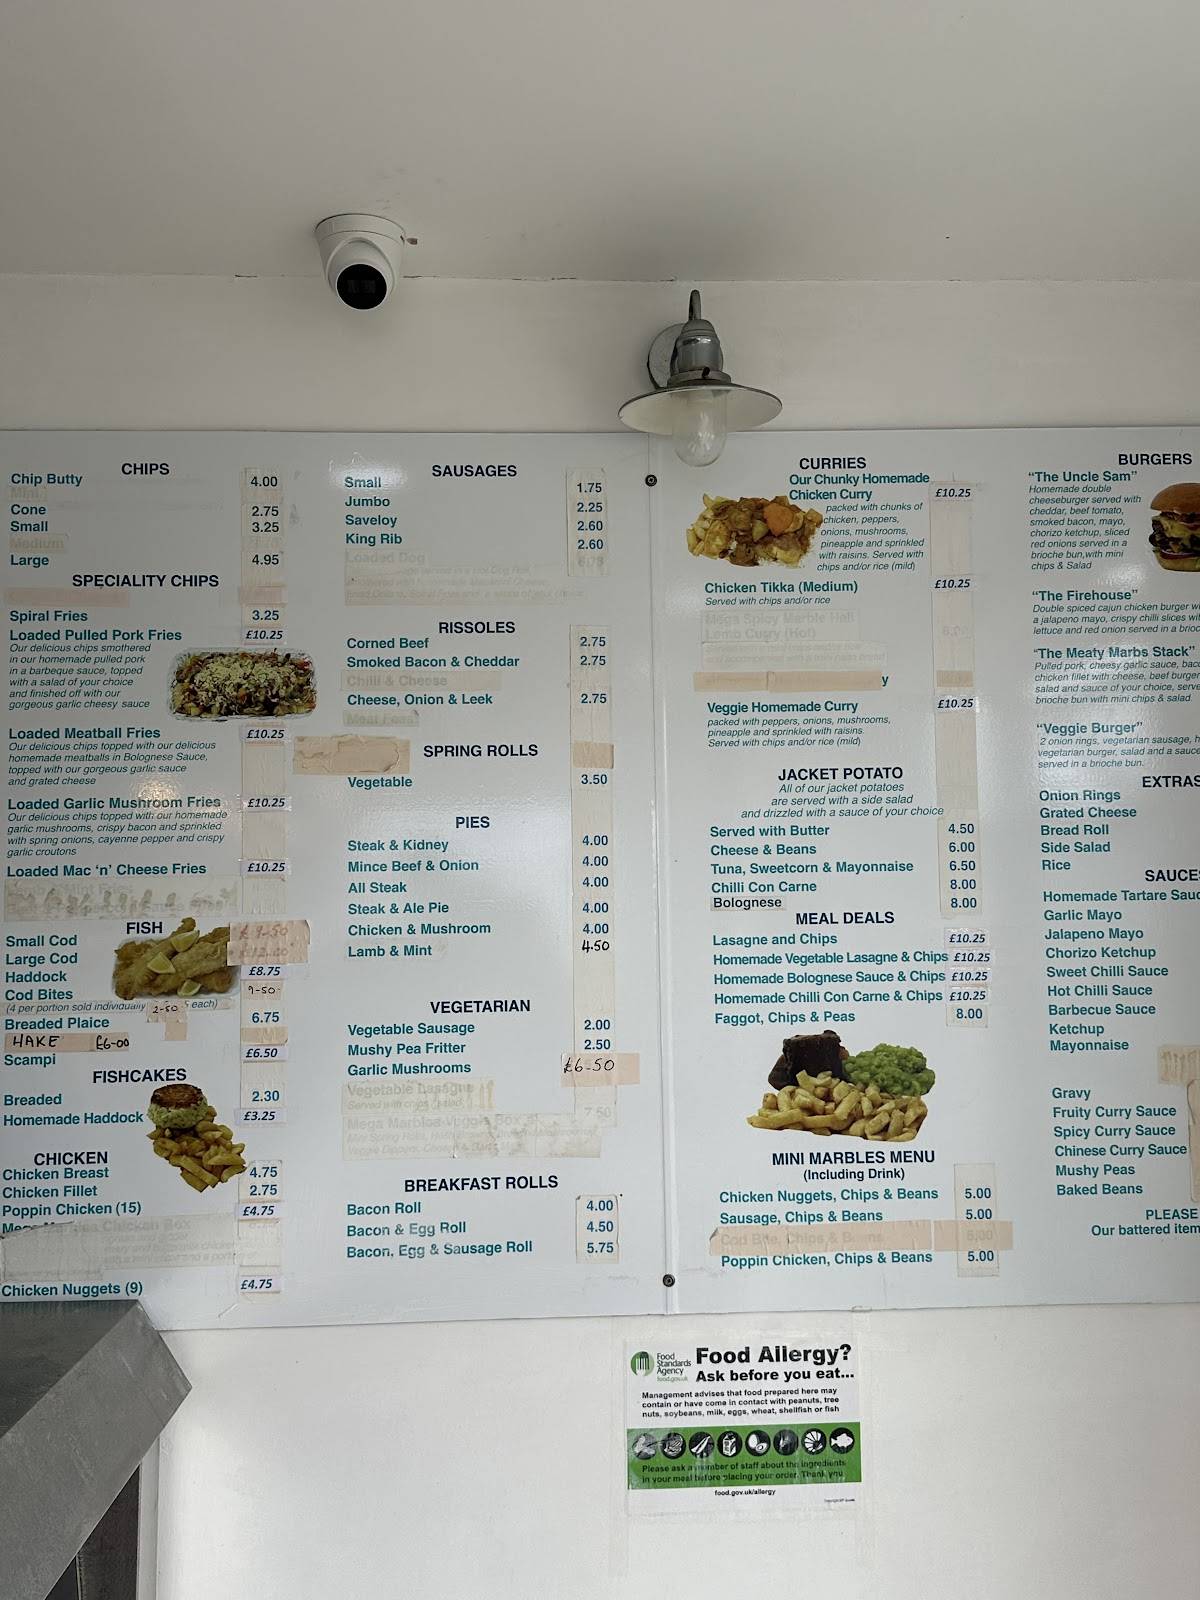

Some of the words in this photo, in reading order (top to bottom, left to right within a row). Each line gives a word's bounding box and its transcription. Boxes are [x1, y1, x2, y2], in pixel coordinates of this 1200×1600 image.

[799, 456, 866, 469] CURRIES
[1118, 452, 1192, 465] BURGERS
[121, 462, 169, 475] CHIPS
[431, 464, 517, 477] SAUSAGES
[11, 472, 42, 487] Chip
[46, 473, 83, 487] Butty
[250, 476, 277, 487] 4.00
[789, 473, 811, 485] Our
[813, 473, 859, 487] Chunky
[862, 472, 930, 484] Homemade
[1062, 471, 1099, 482] Uncle
[789, 489, 837, 500] Chicken
[839, 488, 872, 502] Curry
[935, 488, 971, 497] £10.25
[1028, 484, 1080, 494] Homemade
[1081, 483, 1111, 493] double
[10, 503, 46, 515] Cone
[251, 505, 279, 517] 2.75
[825, 503, 858, 514] packed
[860, 502, 878, 511] with
[879, 502, 911, 511] chunks
[913, 501, 923, 510] of
[10, 520, 48, 532] Small
[251, 521, 279, 533] 3.25
[345, 532, 376, 547] King
[380, 533, 402, 544] Rib
[577, 538, 603, 549] 2.60
[72, 574, 167, 588] SPECIALITY
[170, 574, 219, 587] CHIPS
[704, 582, 756, 593] Chicken
[760, 581, 794, 592] Tikka
[798, 580, 858, 594] (Medium)
[9, 609, 49, 624] Spiral
[54, 609, 88, 621] Fries
[245, 629, 283, 639] £10.25
[438, 621, 515, 634] RISSOLES
[10, 629, 60, 641] Loaded
[65, 629, 107, 640] Pulled
[112, 629, 144, 640] Pork
[148, 629, 182, 640] Fries
[9, 643, 28, 652] Our
[29, 642, 71, 652] delicious
[73, 643, 98, 654] chips
[100, 643, 151, 652] smothered
[346, 656, 400, 667] Smoked
[404, 656, 446, 667] Bacon
[450, 656, 460, 667] &
[464, 655, 519, 667] Cheddar
[580, 655, 606, 666] 2.75
[8, 727, 60, 739] Loaded
[64, 727, 121, 738] Meatball
[126, 726, 160, 738] Fries
[423, 744, 482, 757] SPRING
[487, 743, 538, 756] ROLLS
[581, 773, 607, 784] 3.50
[777, 767, 839, 781] JACKET
[843, 766, 903, 779] POTATO
[347, 775, 412, 790] Vegetable
[1142, 774, 1200, 788] EXTRAS
[1039, 789, 1078, 801] Onion
[1082, 789, 1120, 803] Rings
[455, 815, 490, 828] PIES
[348, 860, 387, 872] Mince
[391, 860, 422, 871] Beef
[425, 860, 435, 871] &
[439, 859, 479, 871] Onion
[582, 855, 608, 866] 4.00
[949, 860, 976, 871] 6.50
[710, 863, 745, 876] Tuna,
[749, 862, 818, 874] Sweetcorn
[822, 861, 832, 873] &
[836, 860, 914, 875] Mayonnaise
[713, 897, 781, 911] Bolognese
[795, 912, 839, 925] MEAL
[843, 911, 894, 924] DEALS
[126, 921, 162, 934] FISH
[5, 935, 44, 947] Small
[48, 934, 77, 946] Cod
[248, 966, 281, 976] £8.75
[1046, 966, 1087, 978] Sweet
[1090, 965, 1124, 977] Chilli
[1127, 965, 1168, 976] Sauce
[430, 999, 530, 1014] VEGETARIAN
[251, 1011, 279, 1023] 6.75
[714, 1012, 763, 1026] Faggot,
[767, 1011, 806, 1025] Chips
[809, 1011, 819, 1022] &
[823, 1010, 855, 1022] Peas
[956, 1008, 982, 1019] 8.00
[4, 1017, 62, 1030] Breaded
[67, 1016, 109, 1028] Plaice
[348, 1043, 392, 1058] Mushy
[396, 1043, 421, 1054] Pea
[425, 1041, 466, 1054] Fritter
[584, 1038, 610, 1050] 2.50
[1049, 1039, 1129, 1053] Mayonnaise
[245, 1047, 278, 1058] £6.50
[3, 1052, 55, 1068] Scampi
[93, 1067, 187, 1083] FISHCAKES
[3, 1112, 80, 1126] Homemade
[83, 1110, 144, 1124] Haddock
[33, 1151, 108, 1166] CHICKEN
[772, 1152, 804, 1165] MINI
[809, 1150, 885, 1164] MARBLES
[889, 1150, 934, 1163] MENU
[803, 1168, 864, 1182] (Including
[868, 1167, 905, 1181] Drink)
[404, 1176, 501, 1192] BREAKFAST
[505, 1174, 558, 1189] ROLLS
[1056, 1183, 1098, 1195] Baked
[1102, 1183, 1143, 1194] Beans
[2, 1203, 51, 1219] Poppin
[55, 1202, 112, 1215] Chicken
[115, 1200, 141, 1216] (15)
[242, 1205, 275, 1216] £4.75
[346, 1203, 390, 1215] Bacon
[394, 1201, 421, 1214] Roll
[586, 1199, 613, 1211] 4.00
[719, 1212, 781, 1226] Sausage,
[784, 1210, 823, 1225] Chips
[827, 1210, 837, 1222] &
[841, 1209, 883, 1221] Beans
[965, 1208, 992, 1220] 5.00
[1145, 1208, 1198, 1220] PLEASE
[586, 1241, 613, 1253] 5.75
[656, 1353, 676, 1361] Food
[696, 1346, 750, 1364] Food
[758, 1343, 851, 1366] Allergy?
[656, 1360, 691, 1368] Standards
[656, 1367, 684, 1376] Agency
[695, 1369, 725, 1382] Ask
[729, 1368, 779, 1381] before
[783, 1370, 810, 1383] you
[641, 1391, 693, 1400] Management
[726, 1389, 742, 1397] that
[743, 1388, 762, 1396] food
[763, 1388, 799, 1397] prepared
[714, 1488, 776, 1497] food.gov.uk/allergy
